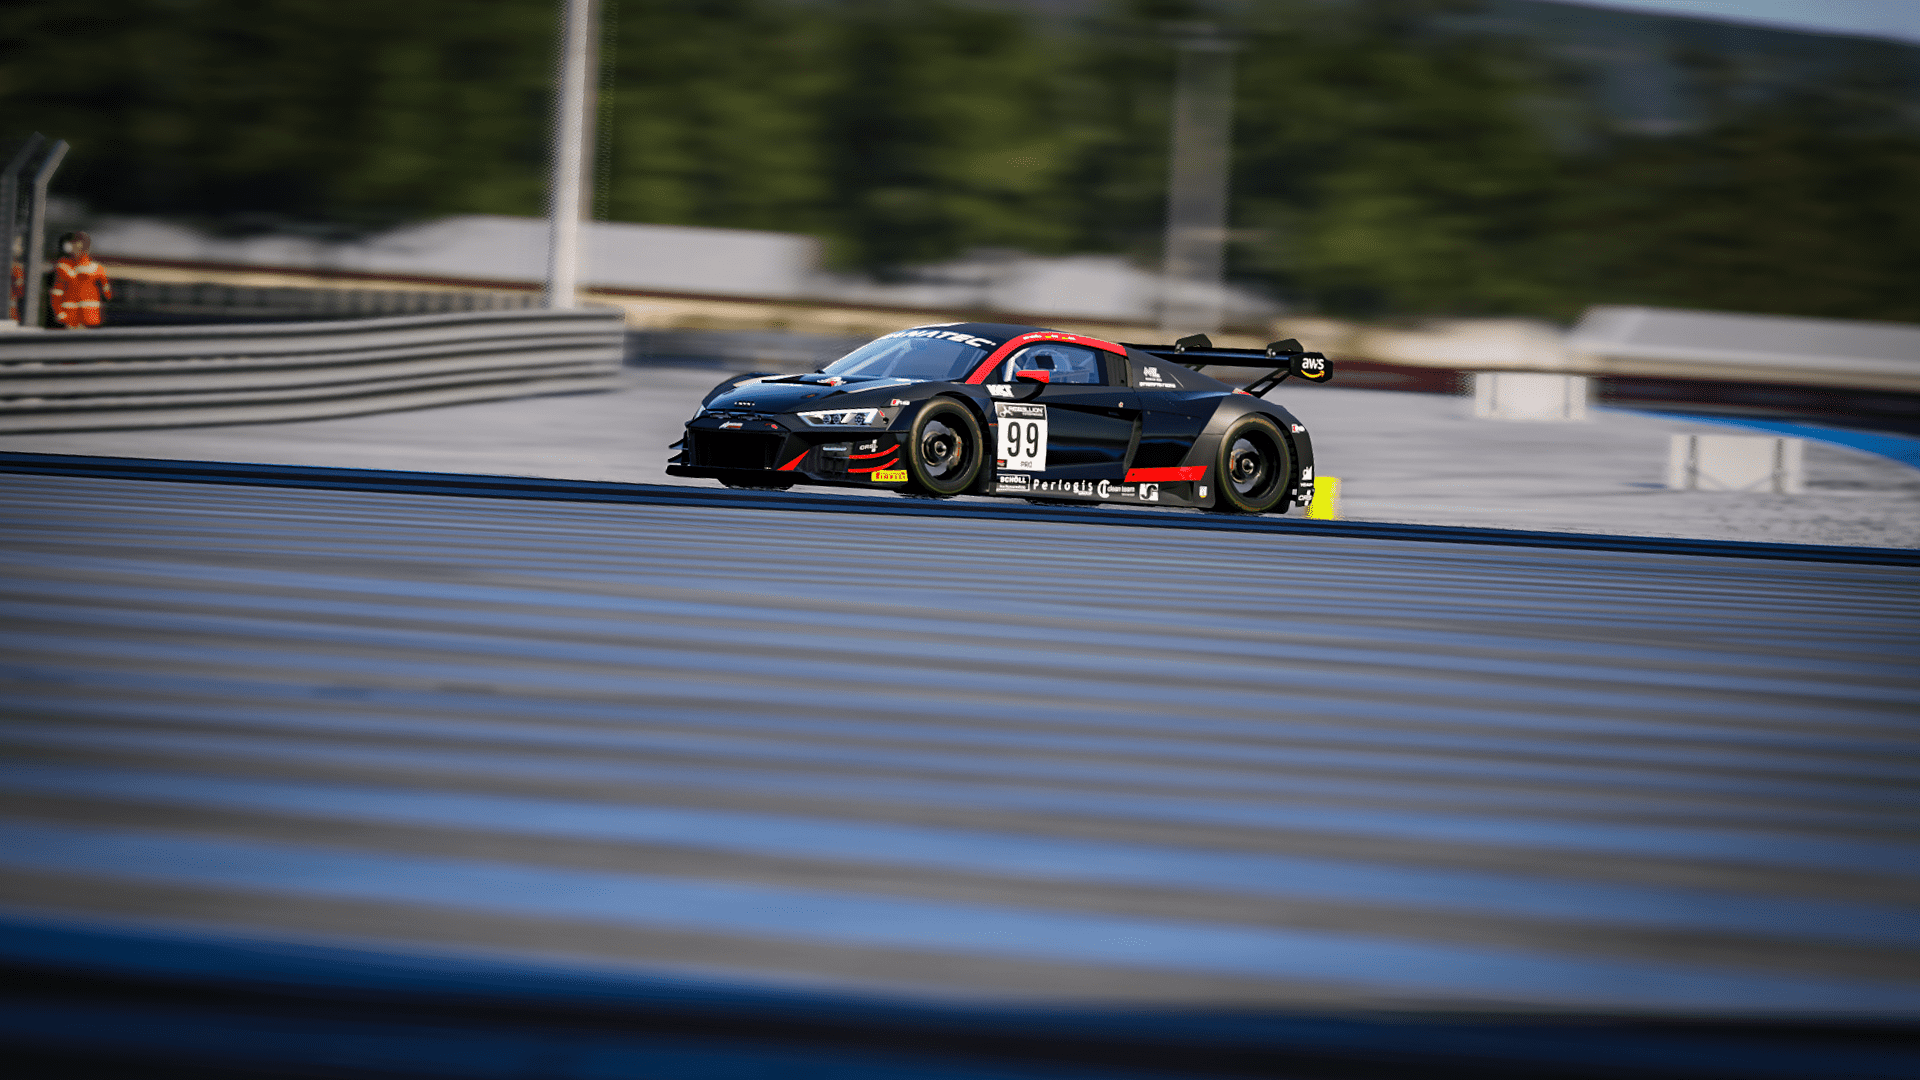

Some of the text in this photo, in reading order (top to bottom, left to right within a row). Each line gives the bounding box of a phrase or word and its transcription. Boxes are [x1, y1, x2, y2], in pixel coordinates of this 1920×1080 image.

[1302, 357, 1325, 370] aws
[1007, 421, 1040, 458] 99
[1033, 479, 1094, 494] Perlogis
